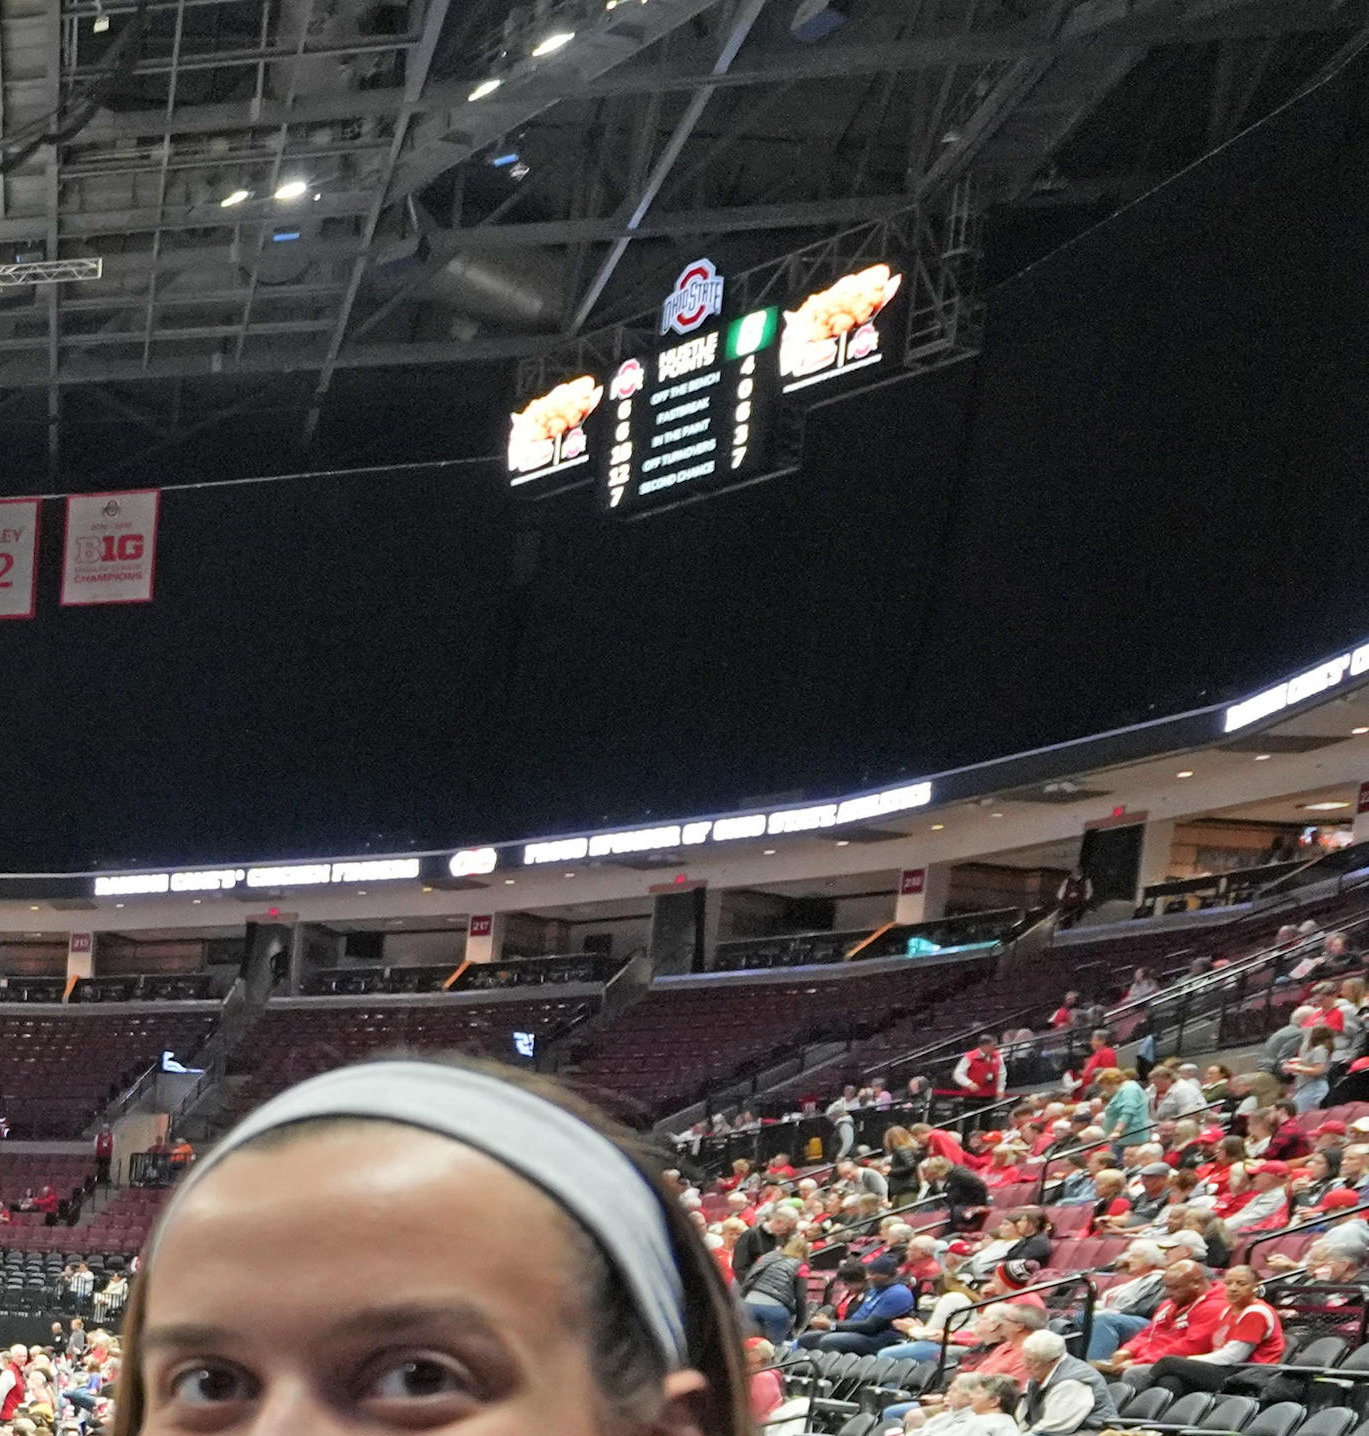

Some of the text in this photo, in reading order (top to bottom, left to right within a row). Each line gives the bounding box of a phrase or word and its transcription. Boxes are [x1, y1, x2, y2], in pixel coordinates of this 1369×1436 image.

[663, 281, 722, 331] OHIO STATE
[73, 572, 143, 583] CHAMPIONS
